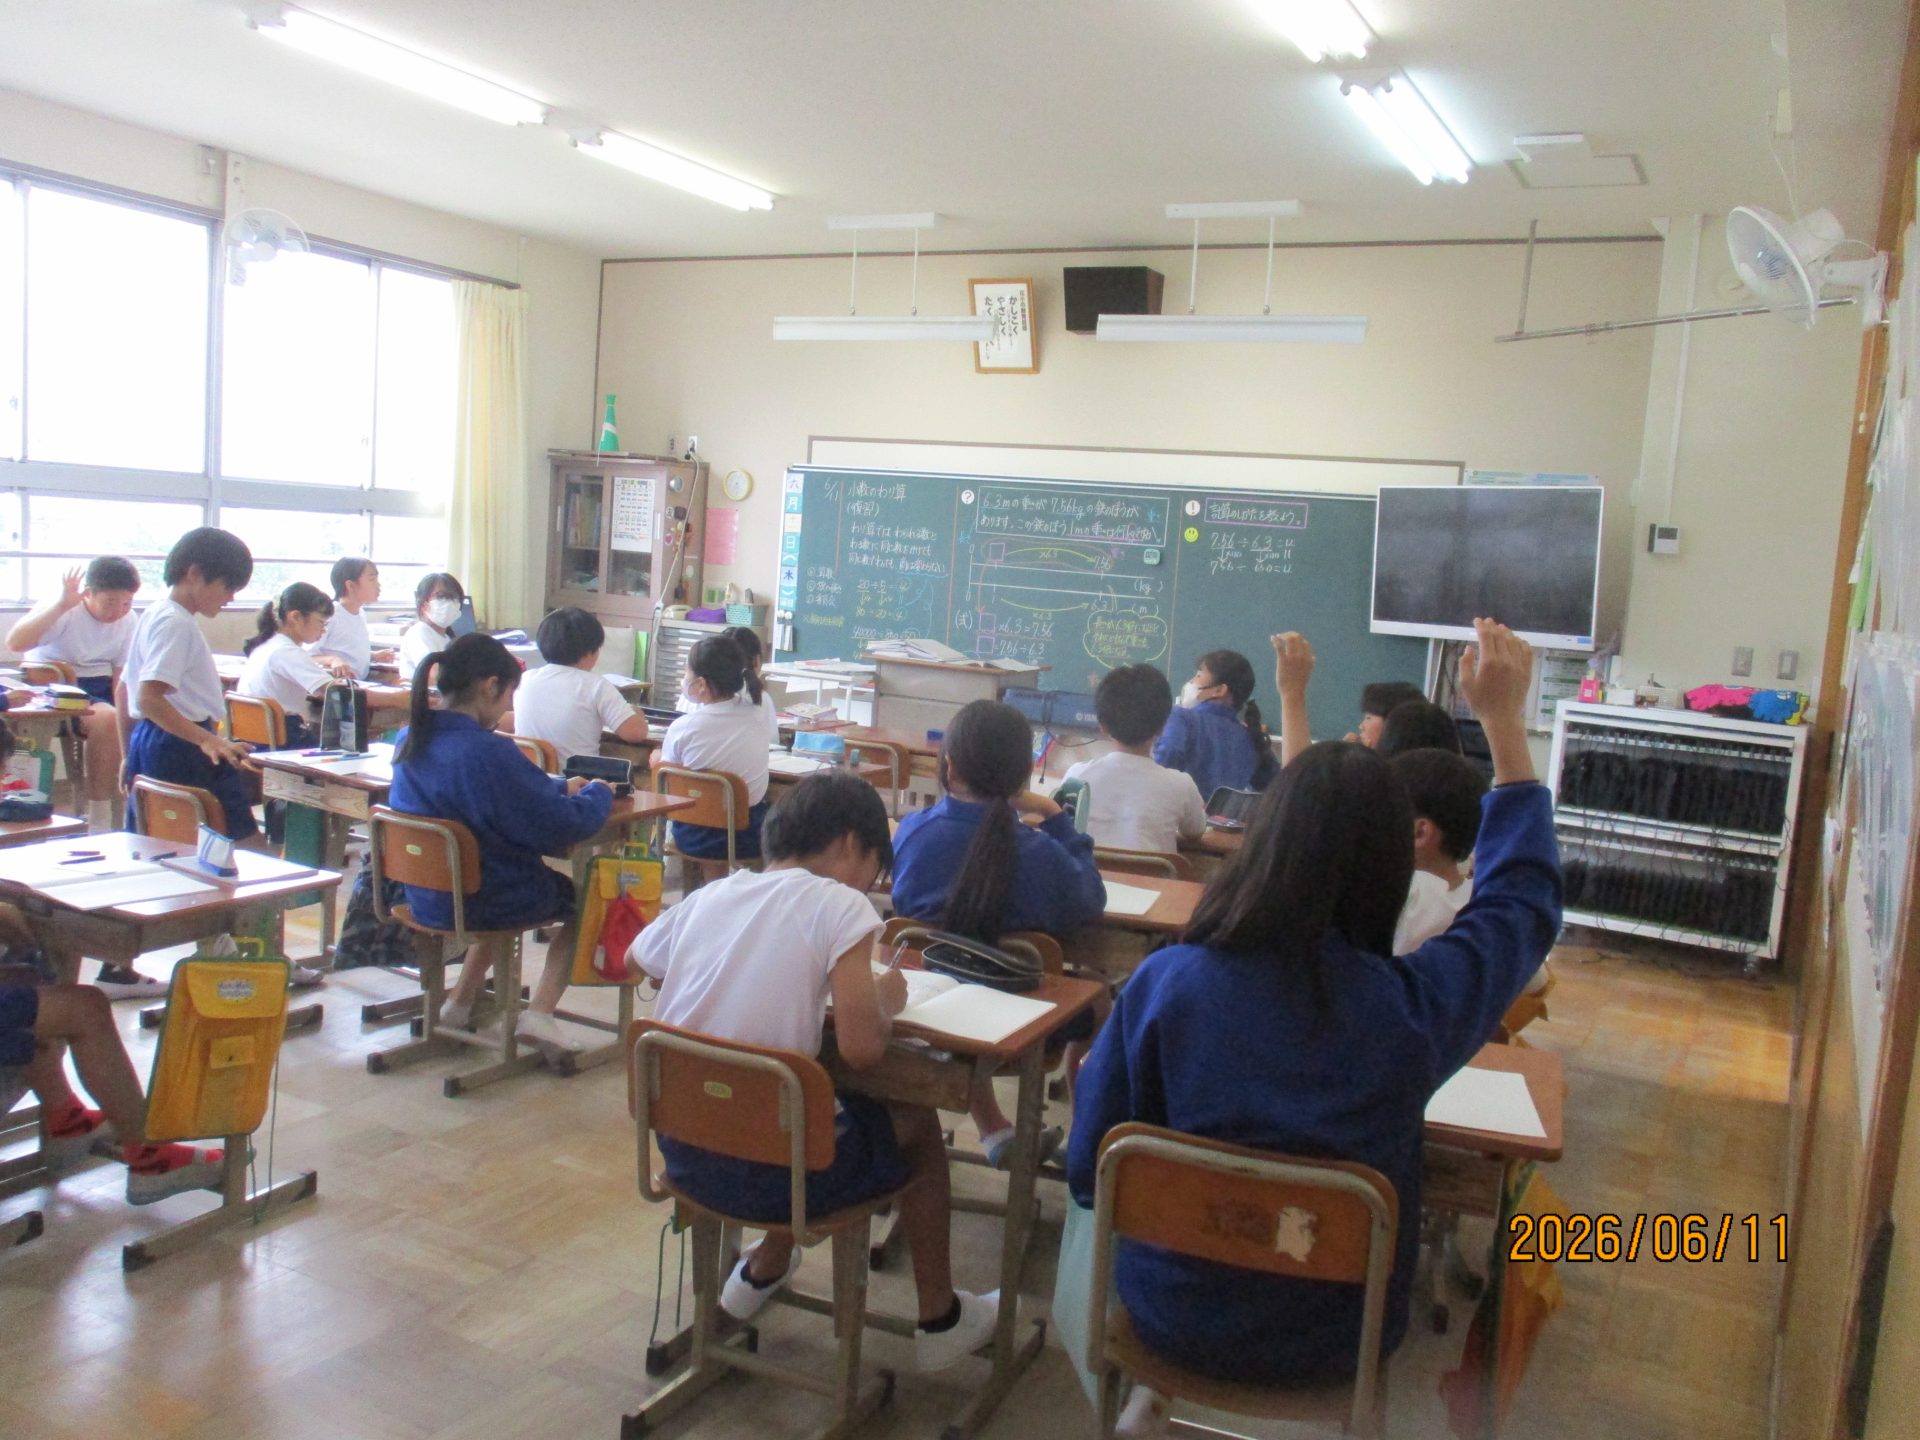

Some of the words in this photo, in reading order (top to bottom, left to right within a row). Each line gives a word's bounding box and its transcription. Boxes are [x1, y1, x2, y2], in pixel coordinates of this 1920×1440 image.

[997, 296, 1006, 336] やさしく
[1009, 296, 1018, 335] かしこく
